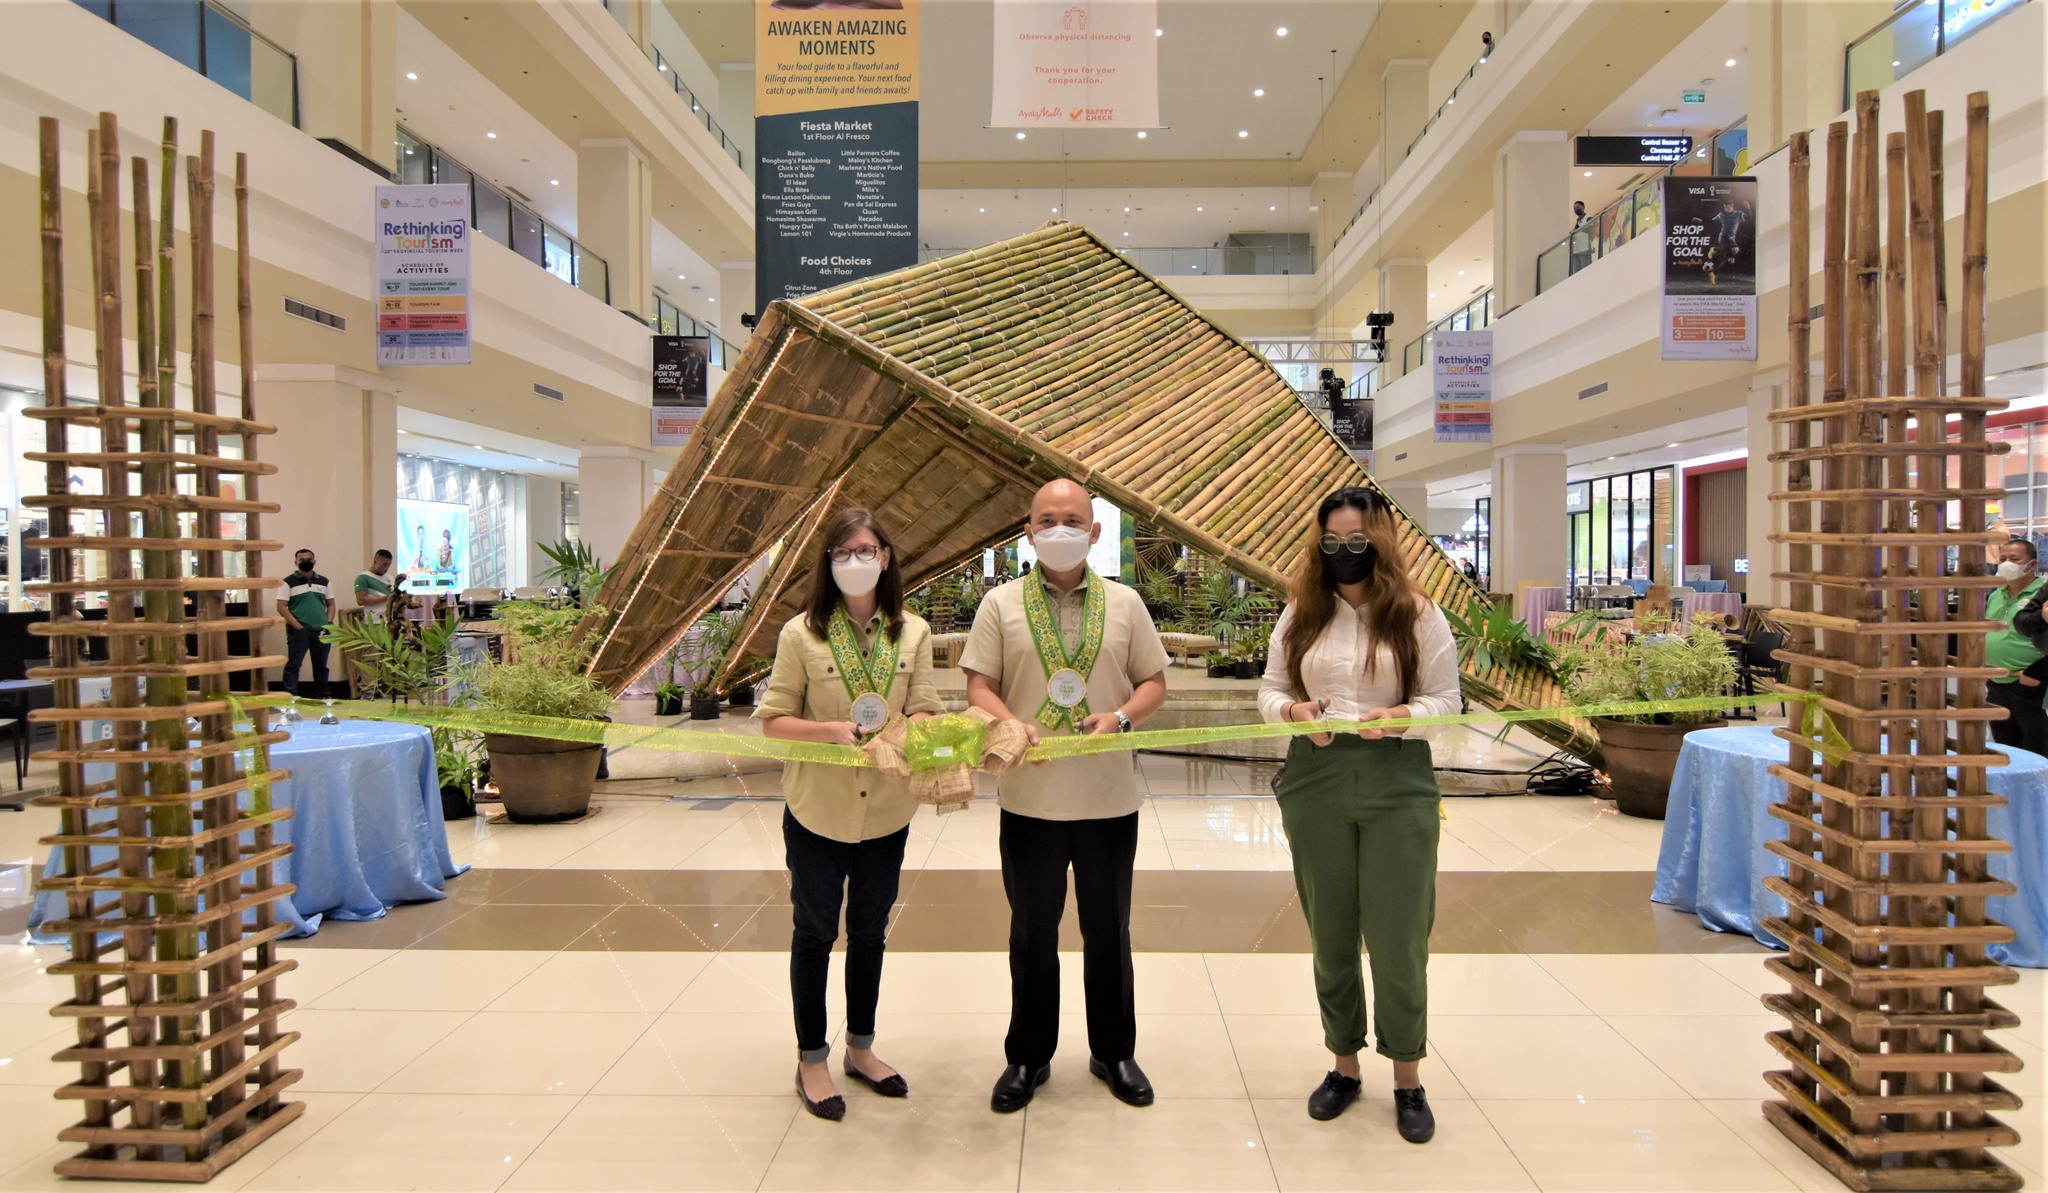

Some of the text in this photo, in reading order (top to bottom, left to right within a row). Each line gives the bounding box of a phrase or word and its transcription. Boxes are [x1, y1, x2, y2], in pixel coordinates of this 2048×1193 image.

[768, 20, 906, 36] AWAKEN AMAZING
[800, 40, 875, 55] MOMENTS
[814, 63, 835, 72] guide
[852, 62, 883, 70] flavorful
[765, 75, 786, 83] filling
[788, 75, 812, 83] dining
[814, 75, 855, 84] experience.
[895, 74, 911, 82] food
[816, 87, 838, 96] family
[801, 122, 872, 131] Fiesta Market
[384, 222, 462, 239] Rethinking
[1672, 225, 1704, 235] SHOP
[1666, 237, 1710, 246] FOR THE
[1673, 247, 1704, 256] GOAL
[801, 257, 871, 266] Food Choices
[1679, 317, 1684, 325] 1
[1674, 330, 1681, 339] 3
[1711, 330, 1724, 339] 10
[1438, 356, 1488, 366] Rethinking
